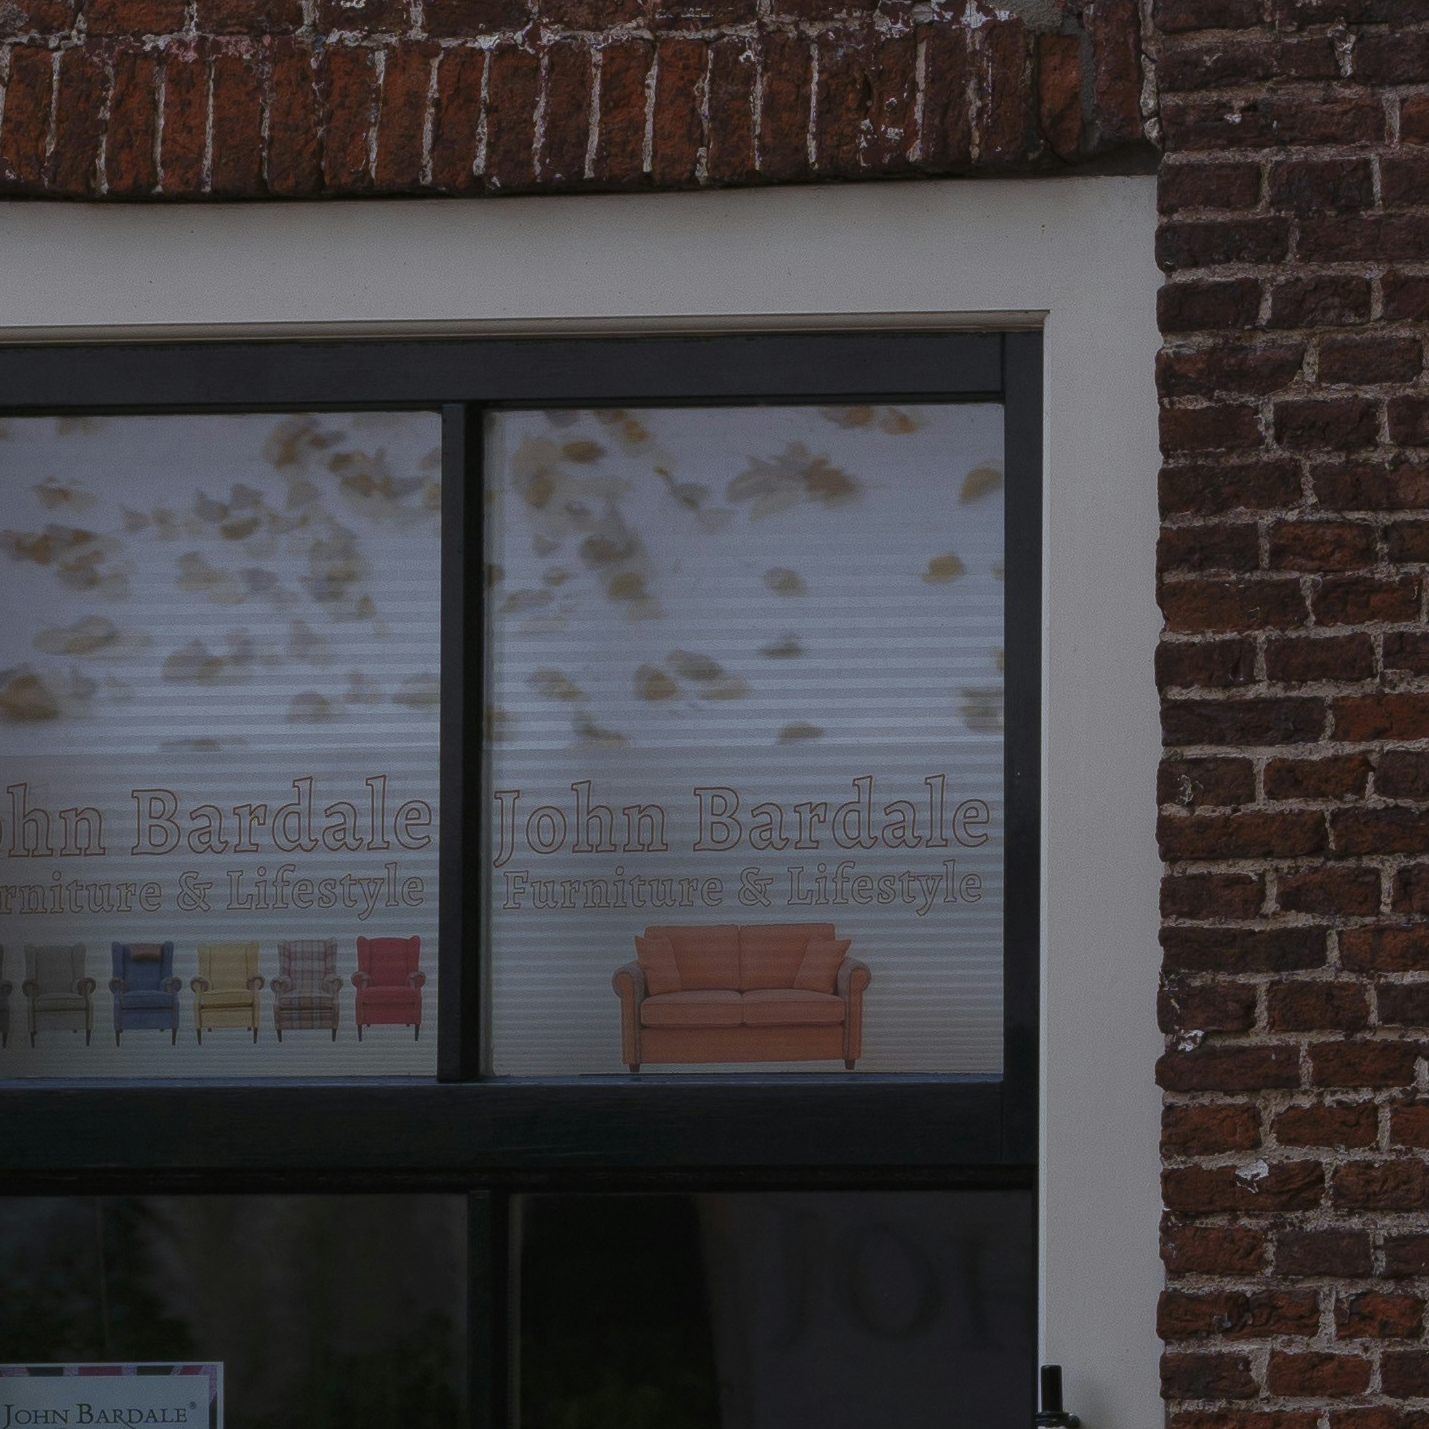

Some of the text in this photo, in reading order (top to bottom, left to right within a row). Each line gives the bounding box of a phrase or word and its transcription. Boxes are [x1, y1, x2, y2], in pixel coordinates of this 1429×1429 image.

[130, 775, 432, 856] Bardale
[493, 773, 991, 868] John Bardale
[176, 871, 213, 912] &
[226, 862, 425, 922] Lifestyle
[502, 859, 983, 917] Furniture & Lifestyle
[1, 1404, 70, 1429] JOHN
